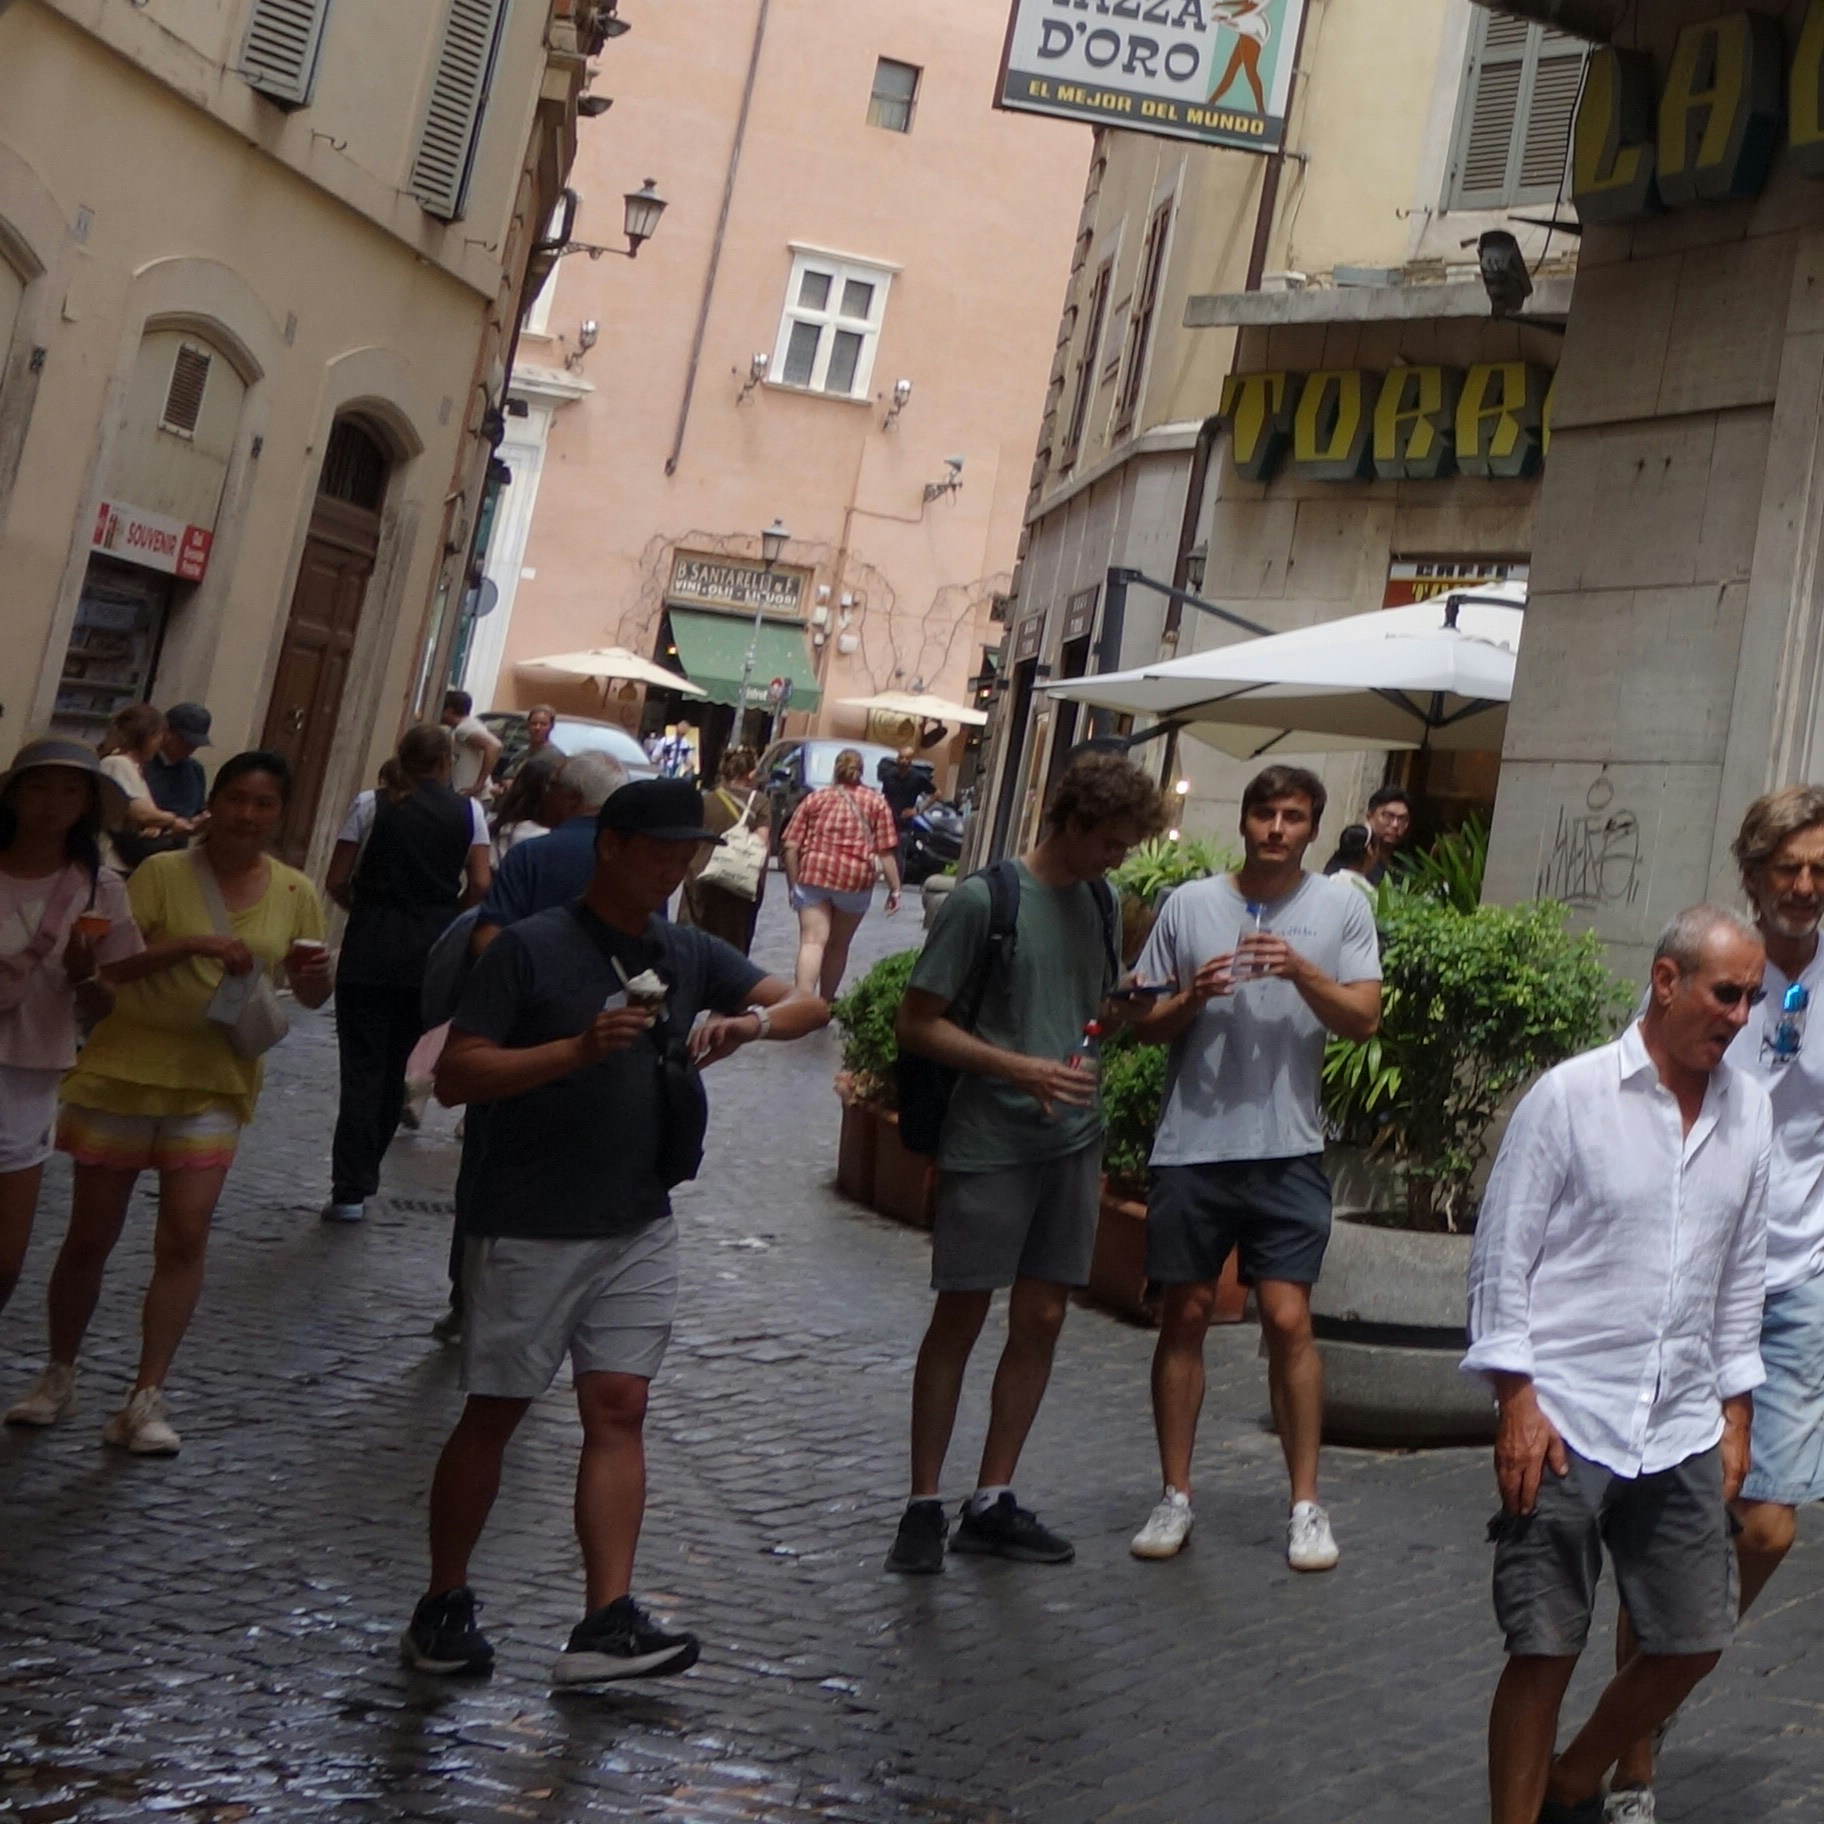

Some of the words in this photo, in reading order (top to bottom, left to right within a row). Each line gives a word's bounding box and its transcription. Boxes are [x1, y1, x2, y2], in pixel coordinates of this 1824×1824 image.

[1036, 17, 1201, 82] D'ORO
[1028, 79, 1051, 98] EL
[1057, 84, 1133, 113] MEJOR
[1140, 99, 1178, 121] DEL
[1186, 107, 1264, 136] MUNDO
[1574, 12, 1755, 204] LA
[1218, 361, 1551, 466] TORR
[127, 521, 178, 557] SOUVENIR
